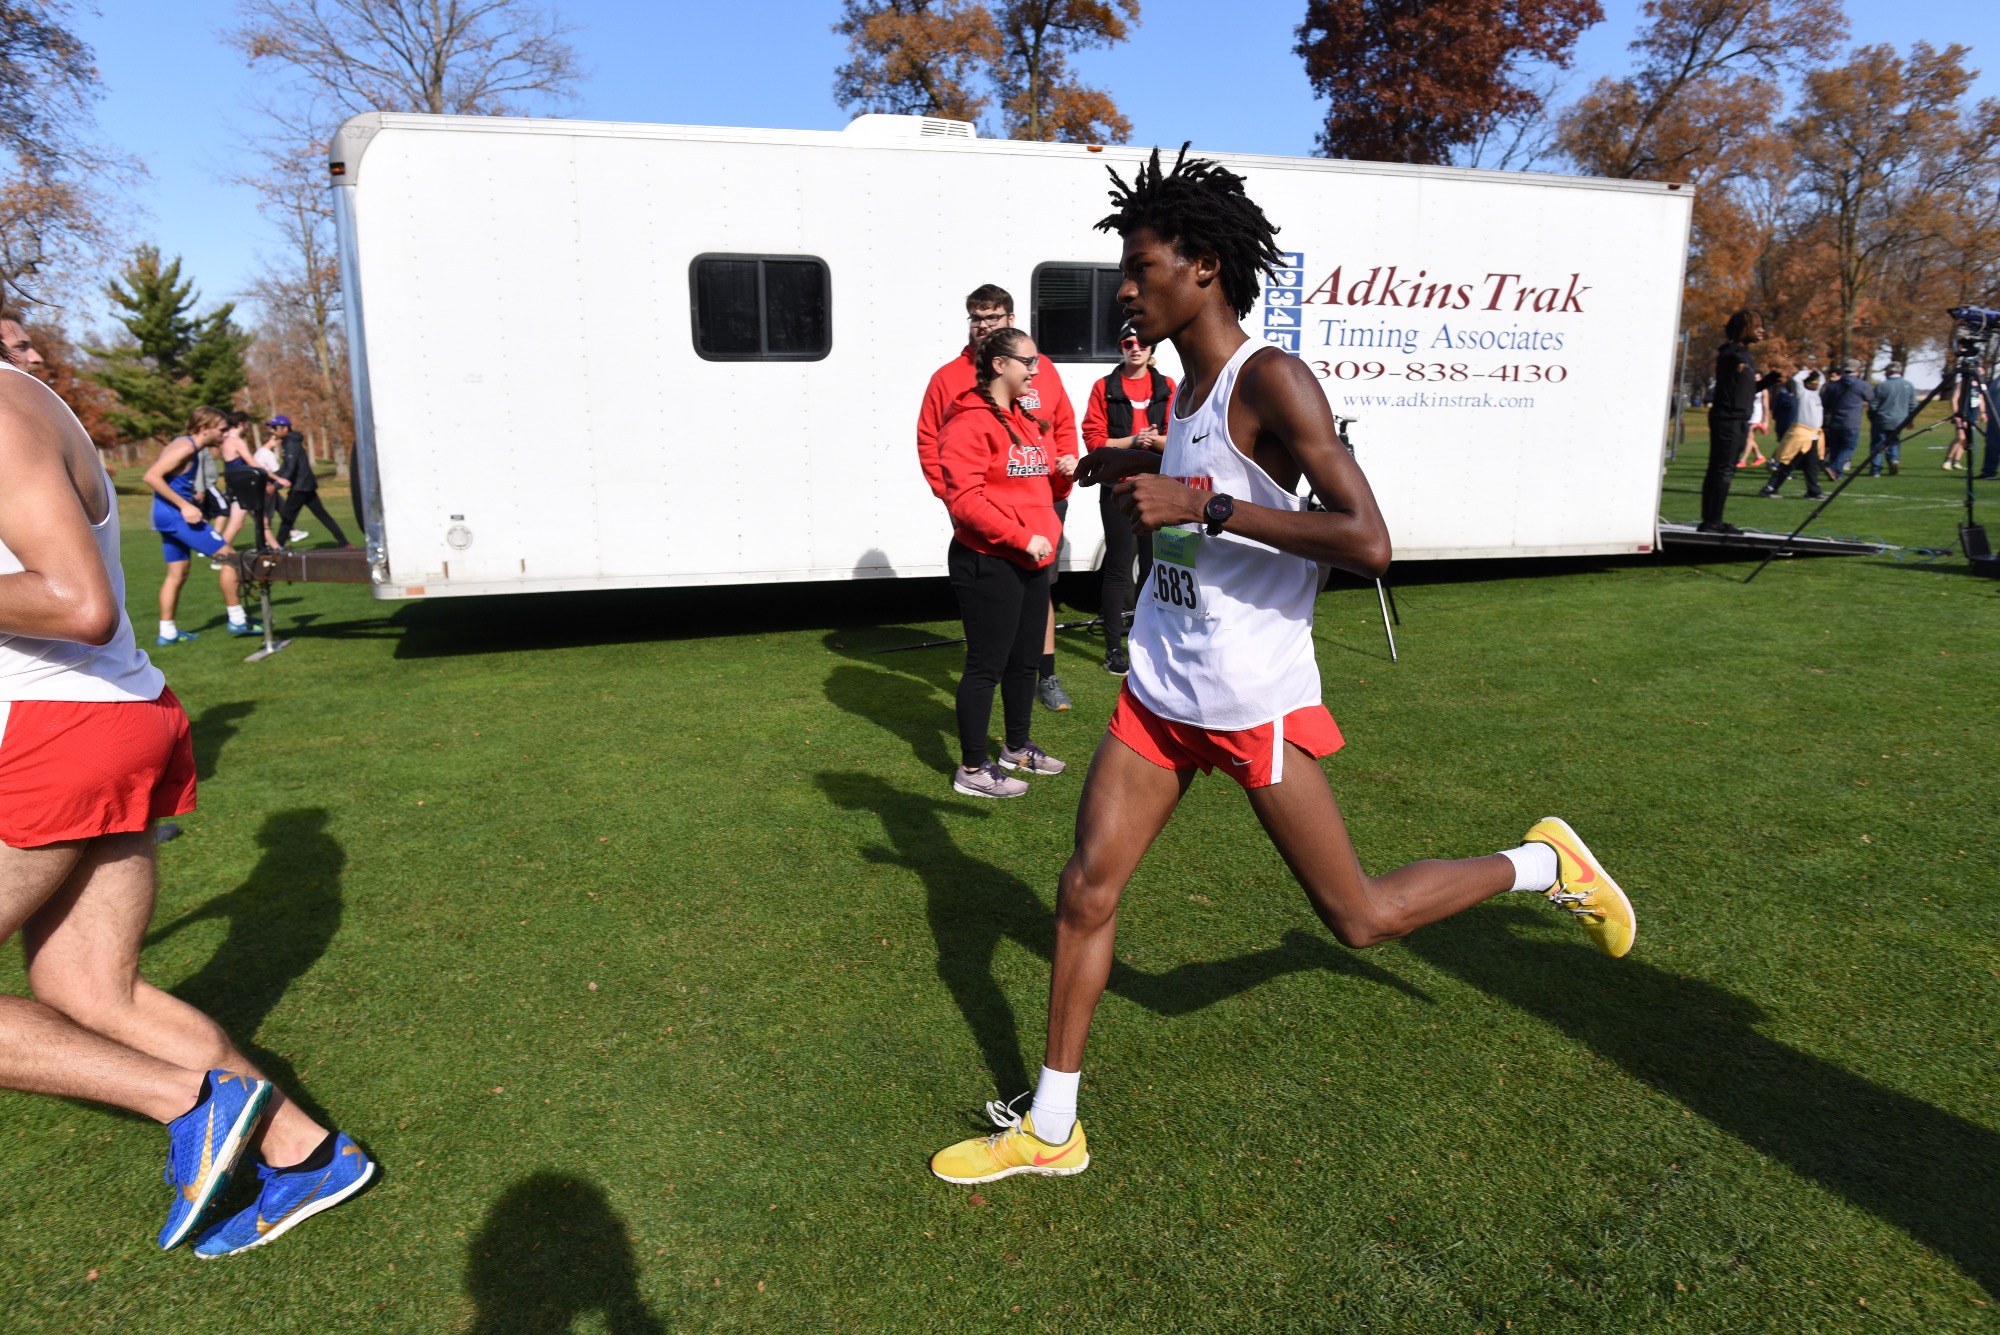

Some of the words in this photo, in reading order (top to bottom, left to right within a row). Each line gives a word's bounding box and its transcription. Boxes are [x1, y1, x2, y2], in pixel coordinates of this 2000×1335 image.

[1300, 265, 1474, 310] Adkins
[1480, 273, 1593, 312] Trak
[1319, 319, 1419, 354] Timing
[1430, 323, 1564, 350] Associates
[1312, 360, 1567, 383] 309-838-4130
[1343, 392, 1534, 407] www.adkinstrak.com
